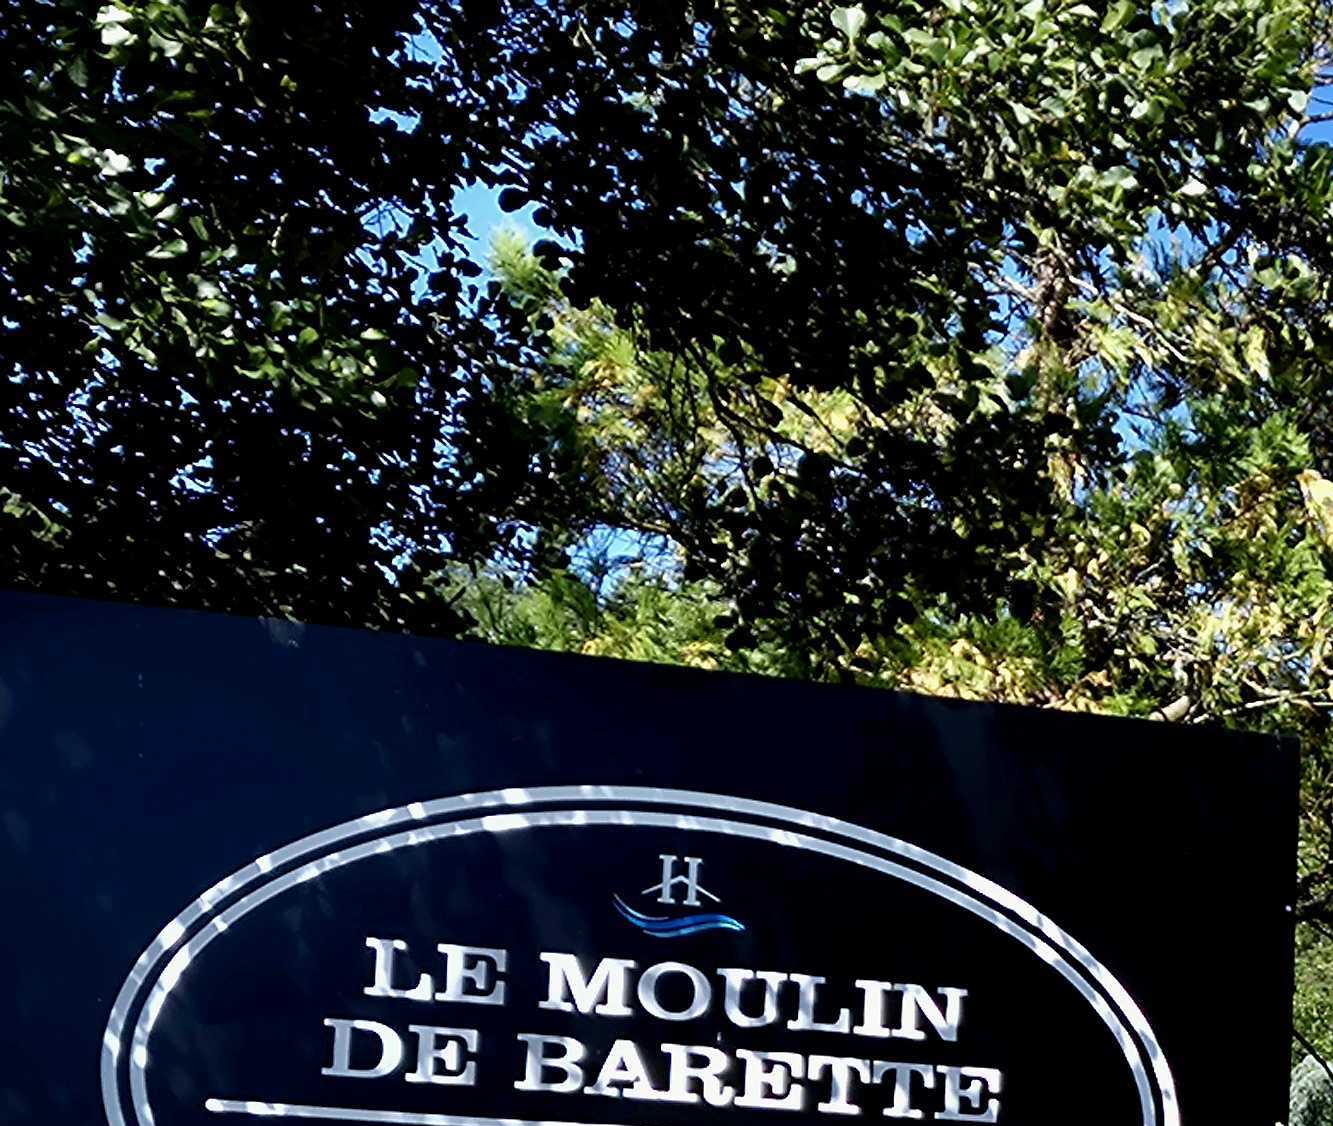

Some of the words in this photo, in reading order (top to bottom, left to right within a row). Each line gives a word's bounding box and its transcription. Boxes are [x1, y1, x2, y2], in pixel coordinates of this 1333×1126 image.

[363, 937, 507, 1005] LE
[538, 952, 968, 1042] MOULIN
[321, 1018, 480, 1086] DE
[514, 1032, 1002, 1123] BARETTE
